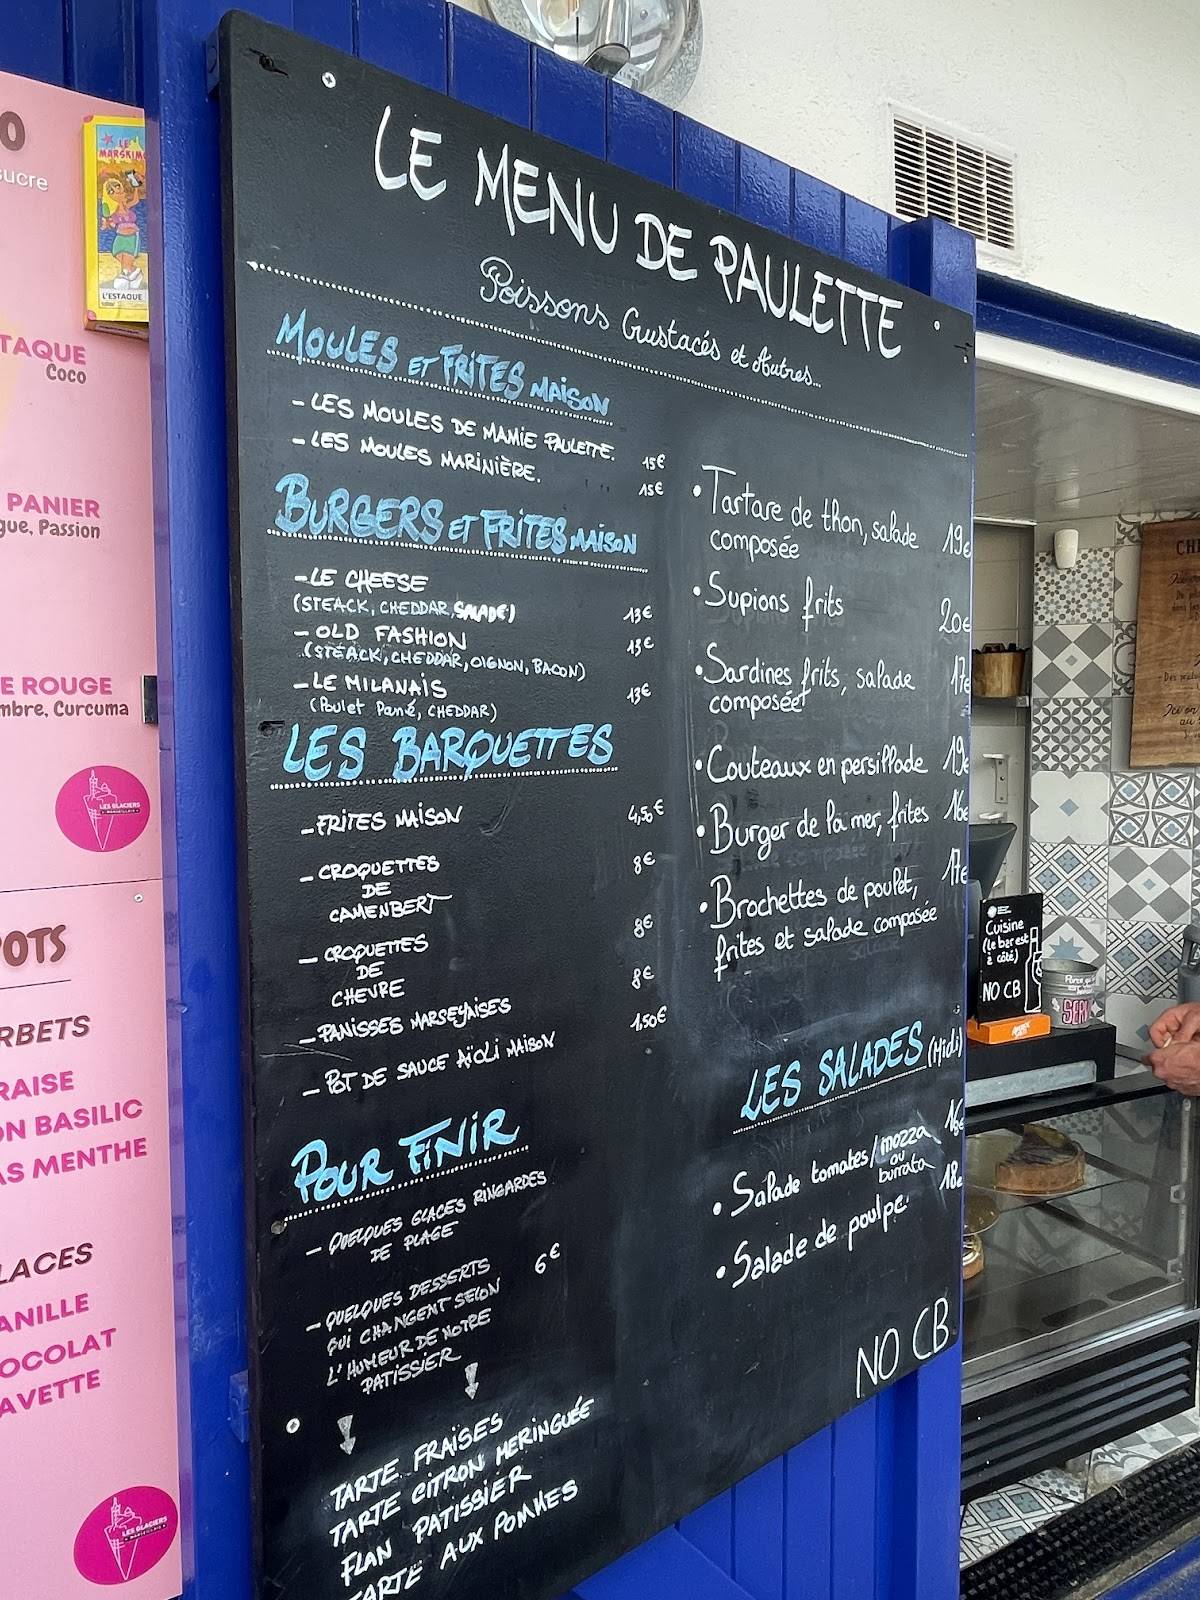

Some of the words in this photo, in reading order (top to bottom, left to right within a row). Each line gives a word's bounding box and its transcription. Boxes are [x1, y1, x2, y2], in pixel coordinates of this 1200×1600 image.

[374, 105, 447, 201] LE
[475, 144, 618, 256] MENU
[634, 212, 698, 281] DE
[711, 235, 904, 360] PAULETTE
[102, 292, 143, 301] L'ESTAQUE
[479, 257, 610, 332] Poissons
[730, 344, 749, 369] et
[275, 308, 399, 374] MOULES
[408, 355, 440, 378] ET
[46, 363, 87, 384] Coco
[311, 392, 355, 420] LES
[362, 399, 444, 435] MOULES
[450, 416, 477, 438] DE
[482, 421, 538, 450] MAMIE
[311, 431, 350, 452] LES
[360, 436, 433, 467] MOULES
[641, 454, 666, 471] 15€
[7, 493, 100, 519] PANIER
[638, 481, 664, 497] 15€
[701, 464, 784, 522] Tartare
[791, 496, 814, 529] de
[821, 498, 868, 546] thon,
[871, 510, 920, 549] salade
[274, 472, 444, 545] BURGERS
[448, 514, 480, 545] ET
[38, 518, 100, 539] Passion
[710, 528, 800, 562] composée
[309, 567, 338, 588] LE
[344, 568, 429, 595] CHEESE
[622, 604, 653, 624] 13€
[704, 570, 790, 617] Supions
[802, 575, 844, 633] frits
[315, 624, 360, 641] OLD
[375, 624, 468, 652] FASHION
[626, 636, 655, 657] 13€
[0, 676, 15, 696] E
[22, 677, 113, 697] ROUGE
[312, 671, 338, 692] LE
[703, 641, 793, 687] Sardines
[798, 655, 848, 707] frits,
[856, 659, 916, 692] salade
[54, 700, 129, 717] Curcuma
[309, 697, 365, 717] (Poulet
[376, 699, 423, 723] Pané,
[427, 704, 498, 724] CHEDDAR)
[626, 684, 652, 705] 13€
[708, 690, 803, 721] composée
[282, 723, 367, 782] LES
[391, 722, 614, 783] BARQUETTES
[706, 744, 812, 784] Couteaux
[817, 758, 836, 777] en
[840, 743, 929, 785] persillade
[710, 802, 790, 862] Burger
[796, 808, 820, 839] de
[826, 798, 848, 835] la
[850, 811, 883, 838] mer,
[887, 790, 930, 842] frites
[318, 855, 441, 881] CROQUETTES
[632, 851, 656, 875] 8€
[329, 892, 453, 924] CAMENBERT
[361, 881, 392, 900] DE
[710, 874, 828, 929] Brochettes
[836, 876, 859, 906] de
[862, 867, 919, 909] poulet,
[633, 914, 654, 938] 8€
[713, 933, 766, 983] frites
[774, 925, 795, 952] et
[803, 916, 869, 948] salade
[873, 900, 938, 938] composée
[985, 918, 1025, 937] Cuisine
[998, 935, 1015, 950] bar
[1015, 932, 1030, 945] est
[0, 924, 67, 968] OTS
[323, 933, 429, 964] CROQUETTES
[356, 962, 384, 981] DE
[631, 965, 655, 990] 8€
[331, 978, 406, 1009] CHEVRE
[982, 981, 1001, 1003] NO
[1003, 980, 1022, 1000] CB
[324, 1068, 359, 1095] POT
[361, 1067, 387, 1090] DE
[397, 1052, 451, 1081] SAUCE
[740, 1060, 801, 1122] LES
[818, 1020, 923, 1097] SALADES
[35, 1098, 143, 1136] BASILIC
[32, 1137, 147, 1179] MENTHE
[290, 1138, 394, 1204] POUR
[878, 1153, 936, 1184] burrata
[890, 1151, 906, 1166] ou
[730, 1171, 801, 1218] Salade
[328, 1215, 403, 1255] QUELQUES
[411, 1197, 466, 1228] GLACES
[370, 1242, 393, 1264] DE
[404, 1220, 459, 1252] PLAGE
[534, 1242, 561, 1275] 6€
[732, 1233, 807, 1289] Salade
[814, 1218, 837, 1248] de
[325, 1290, 403, 1332] QUELQUES
[409, 1258, 491, 1301] DESSERTS
[359, 1298, 452, 1345] CHANGENT
[454, 1277, 501, 1310] SELON
[415, 1327, 440, 1351] DE
[443, 1307, 492, 1342] NOTRE
[0, 1327, 117, 1379] OCOLAT
[857, 1328, 900, 1399] NO
[913, 1297, 949, 1360] CB
[0, 1369, 101, 1418] AVETTE
[329, 1458, 400, 1512] TARTE
[329, 1490, 402, 1548] TARTE
[439, 1527, 485, 1570] AUX
[493, 1479, 579, 1541] POMMES
[340, 1537, 393, 1587] FLAN
